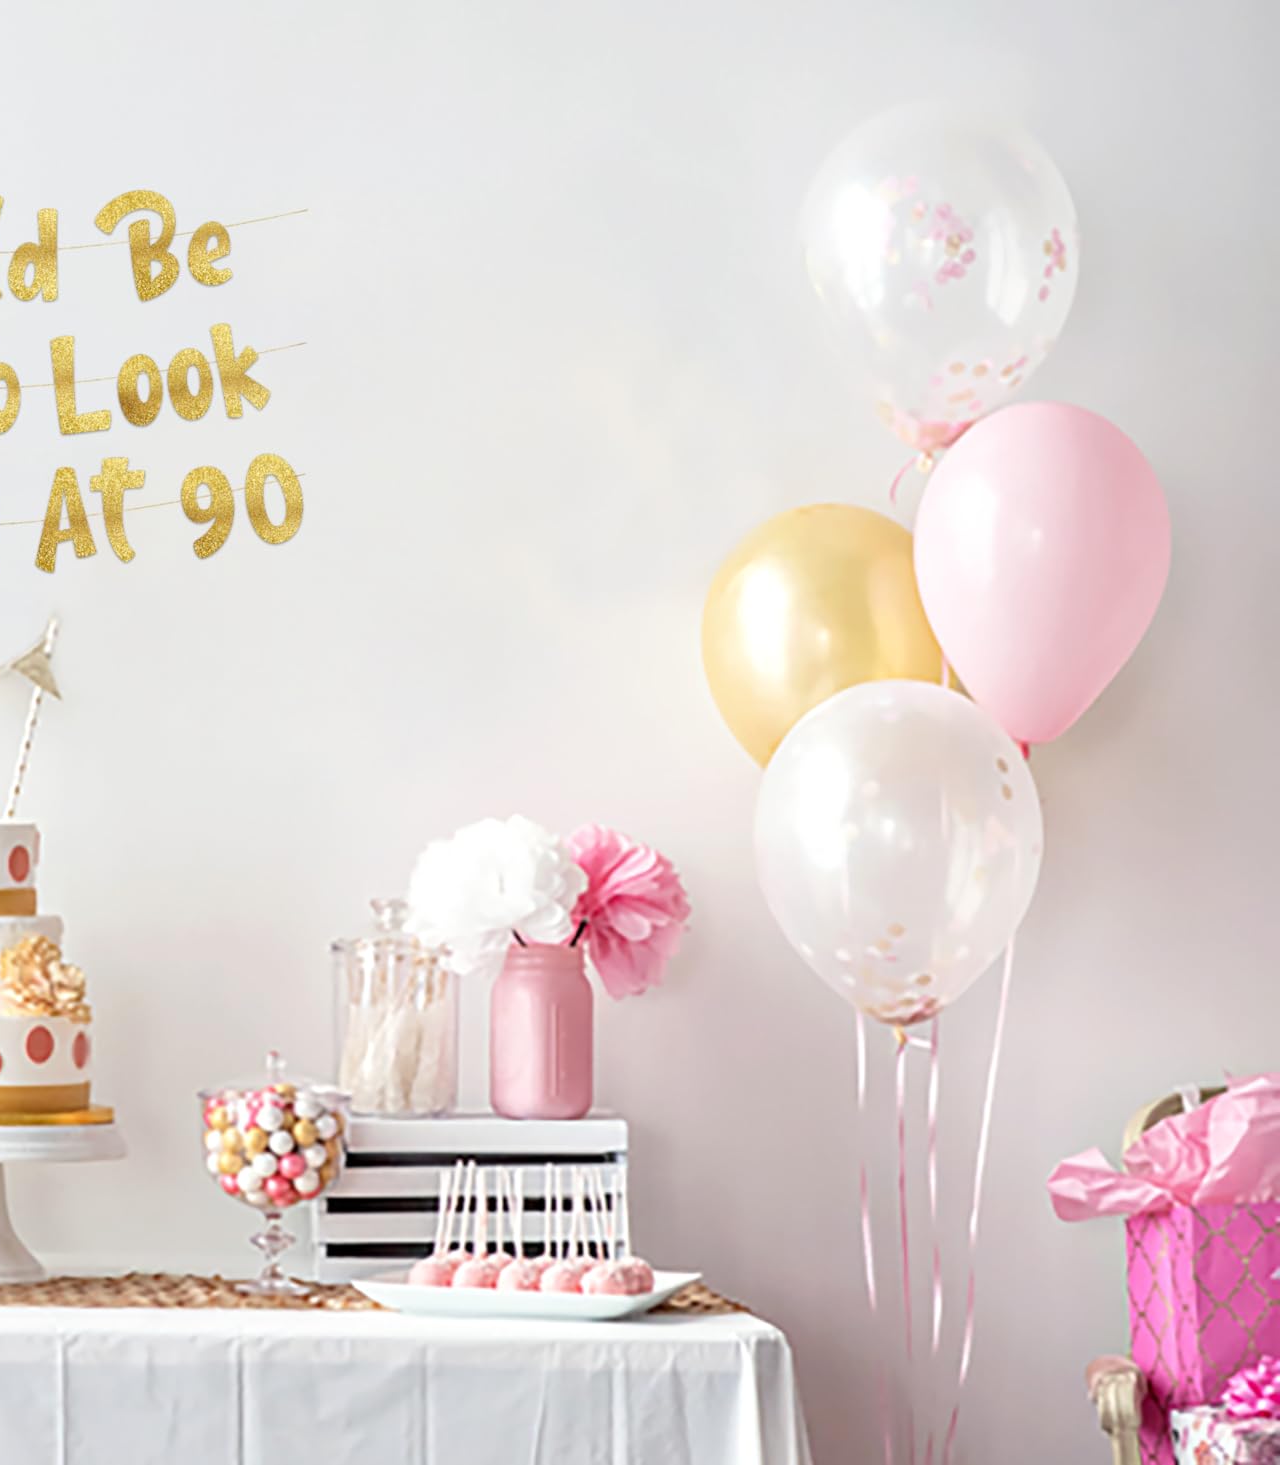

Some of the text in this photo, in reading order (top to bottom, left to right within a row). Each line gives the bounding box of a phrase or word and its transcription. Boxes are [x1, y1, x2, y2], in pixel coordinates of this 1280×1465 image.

[94, 189, 233, 302] Be
[50, 323, 271, 436] Look
[35, 457, 146, 574] At
[180, 453, 304, 559] 90
